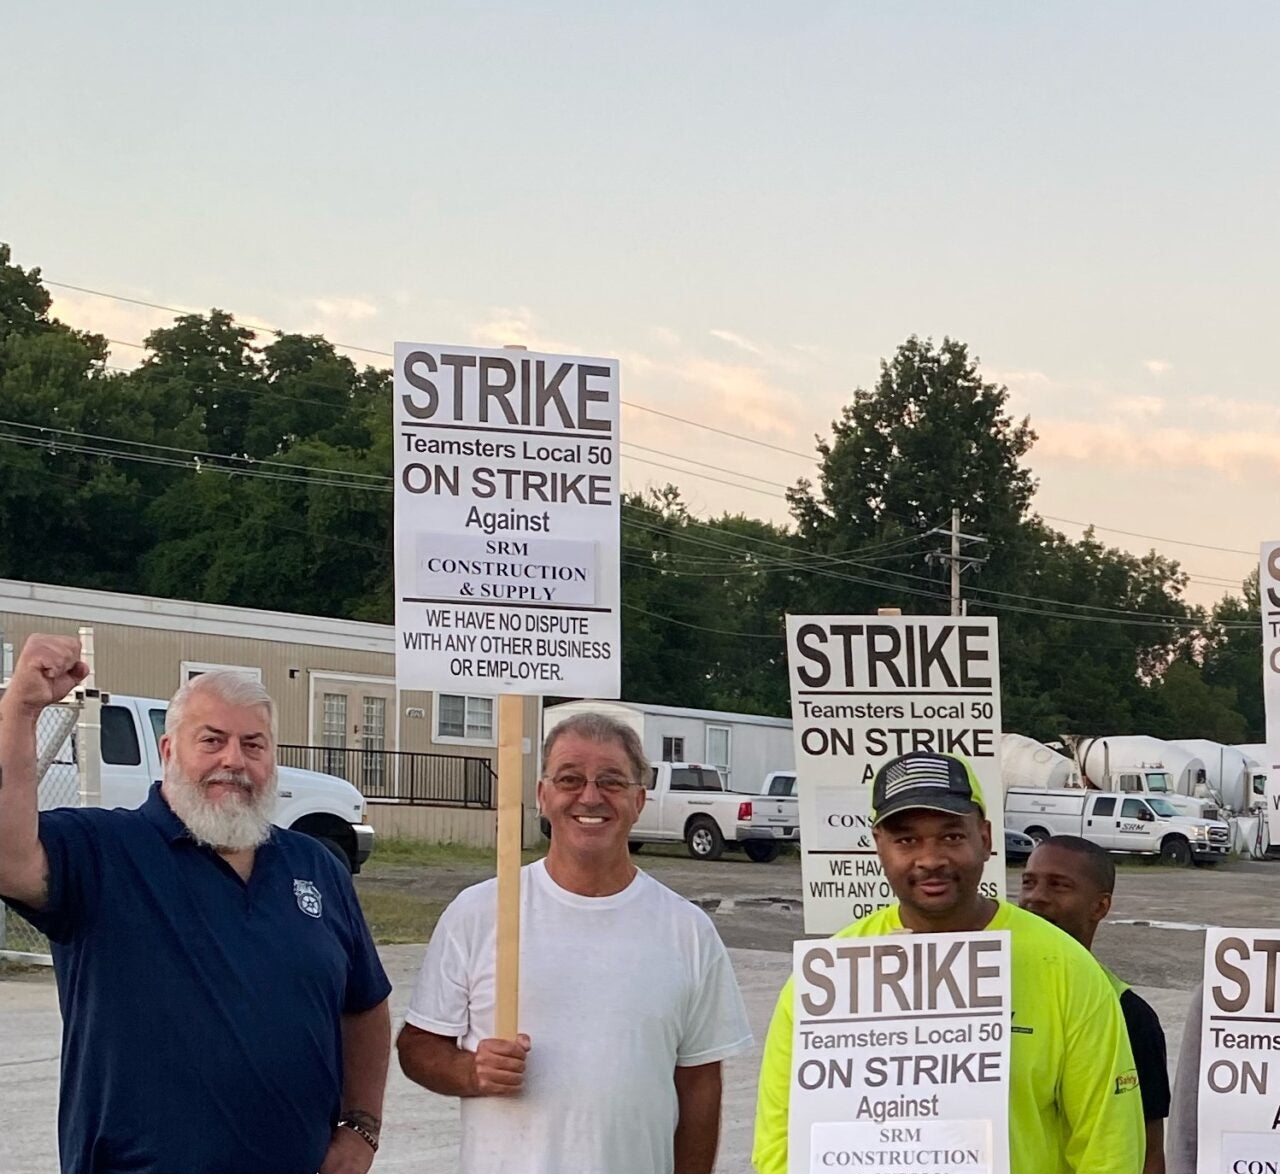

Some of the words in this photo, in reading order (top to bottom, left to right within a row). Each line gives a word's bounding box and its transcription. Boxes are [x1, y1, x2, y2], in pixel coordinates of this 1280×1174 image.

[401, 351, 611, 431] STRIKE
[402, 433, 515, 458] Teamsters
[523, 441, 580, 463] Local
[588, 446, 611, 465] 50
[403, 463, 459, 496] ON
[472, 467, 612, 505] STRIKE
[465, 506, 549, 535] Against
[487, 541, 527, 556] SRM
[428, 559, 585, 581] CONSTRUCTION
[460, 583, 474, 596] &
[481, 584, 555, 600] SUPPLY
[426, 610, 451, 627] WE
[455, 611, 495, 630] HAVE
[500, 613, 521, 631] NO
[526, 615, 588, 635] DISPUTE
[403, 632, 441, 650] WITH
[445, 634, 477, 652] ANY
[481, 636, 532, 655] OTHER
[537, 639, 610, 659] BUSINESS
[797, 624, 992, 688] STRIKE
[451, 658, 473, 676] OR
[477, 660, 563, 680] EMPLOYER.
[799, 701, 904, 718] Teamsters
[911, 702, 964, 718] Local
[971, 702, 993, 719] 50
[801, 728, 853, 755] ON
[1121, 823, 1145, 831] SRM
[857, 835, 870, 847] &
[830, 860, 852, 876] WE
[856, 861, 884, 875] HAV
[810, 882, 844, 897] WITH
[848, 882, 876, 897] ANY
[853, 904, 874, 919] OR
[801, 940, 1003, 1017] STRIKE
[800, 1029, 908, 1049] Teamsters
[915, 1024, 972, 1044] Local
[979, 1023, 1002, 1041] 50
[798, 1058, 853, 1090] ON
[864, 1052, 1001, 1087] STRIKE
[1208, 1060, 1268, 1095] ON
[856, 1094, 939, 1123] Against
[880, 1128, 920, 1142] SRM
[823, 1150, 978, 1166] CONSTRUCTION
